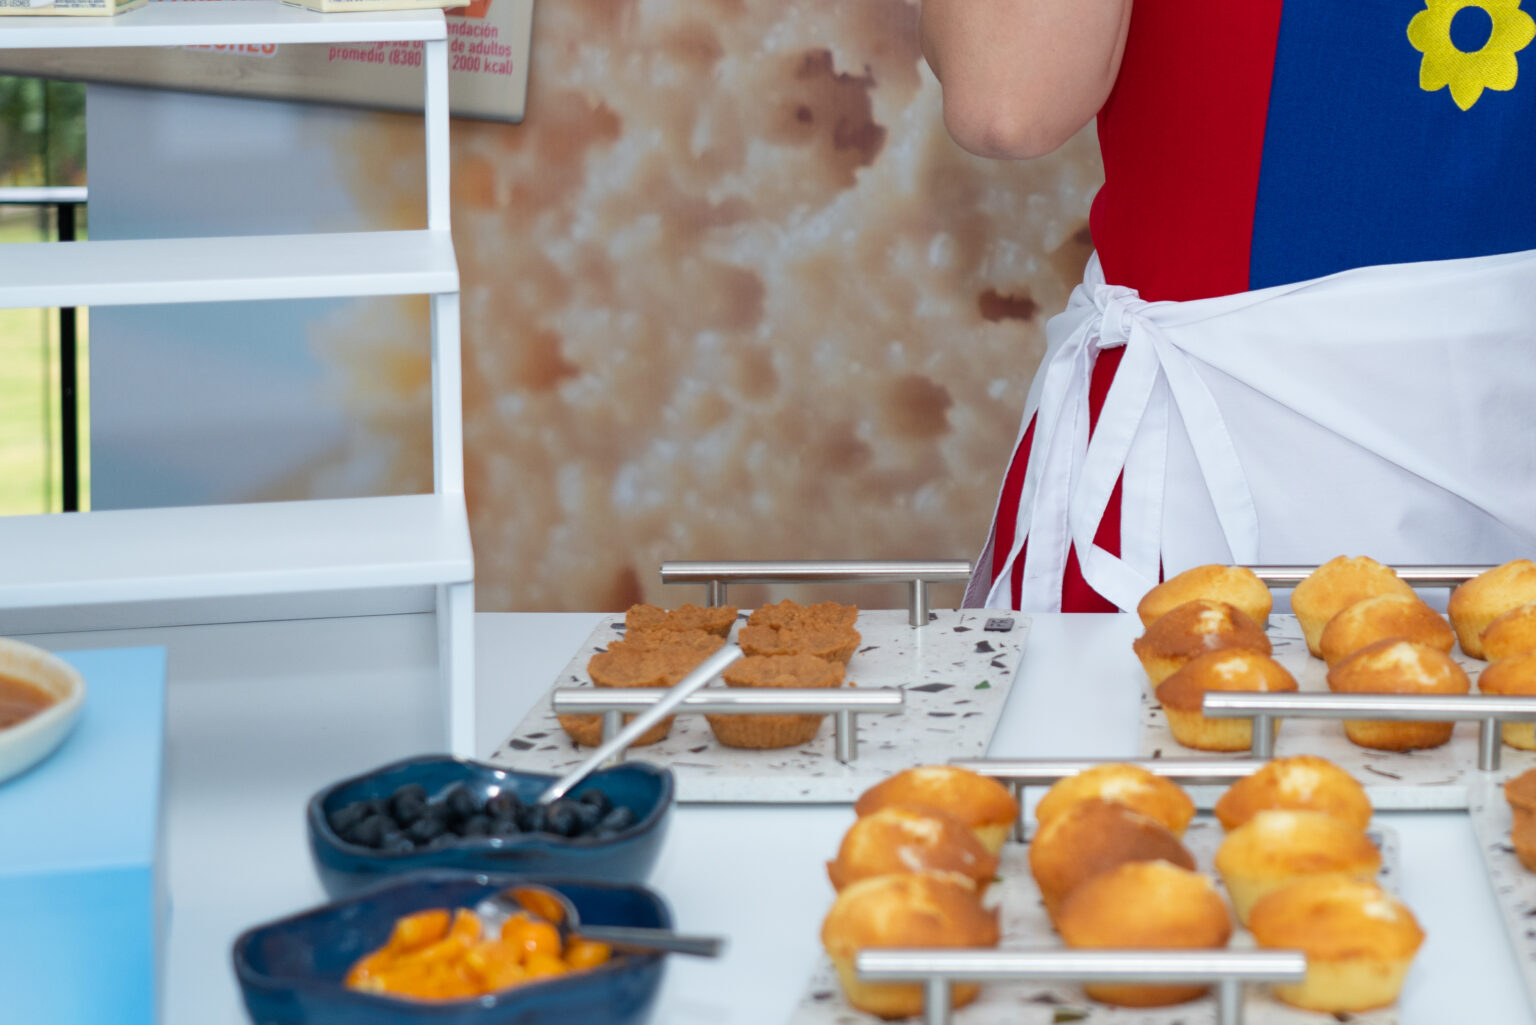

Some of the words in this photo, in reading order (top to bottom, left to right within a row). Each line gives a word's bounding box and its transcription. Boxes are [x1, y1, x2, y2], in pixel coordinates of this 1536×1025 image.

[328, 46, 385, 64] promedio
[451, 38, 465, 53] de
[468, 39, 512, 58] adultos
[452, 54, 481, 72] 2000
